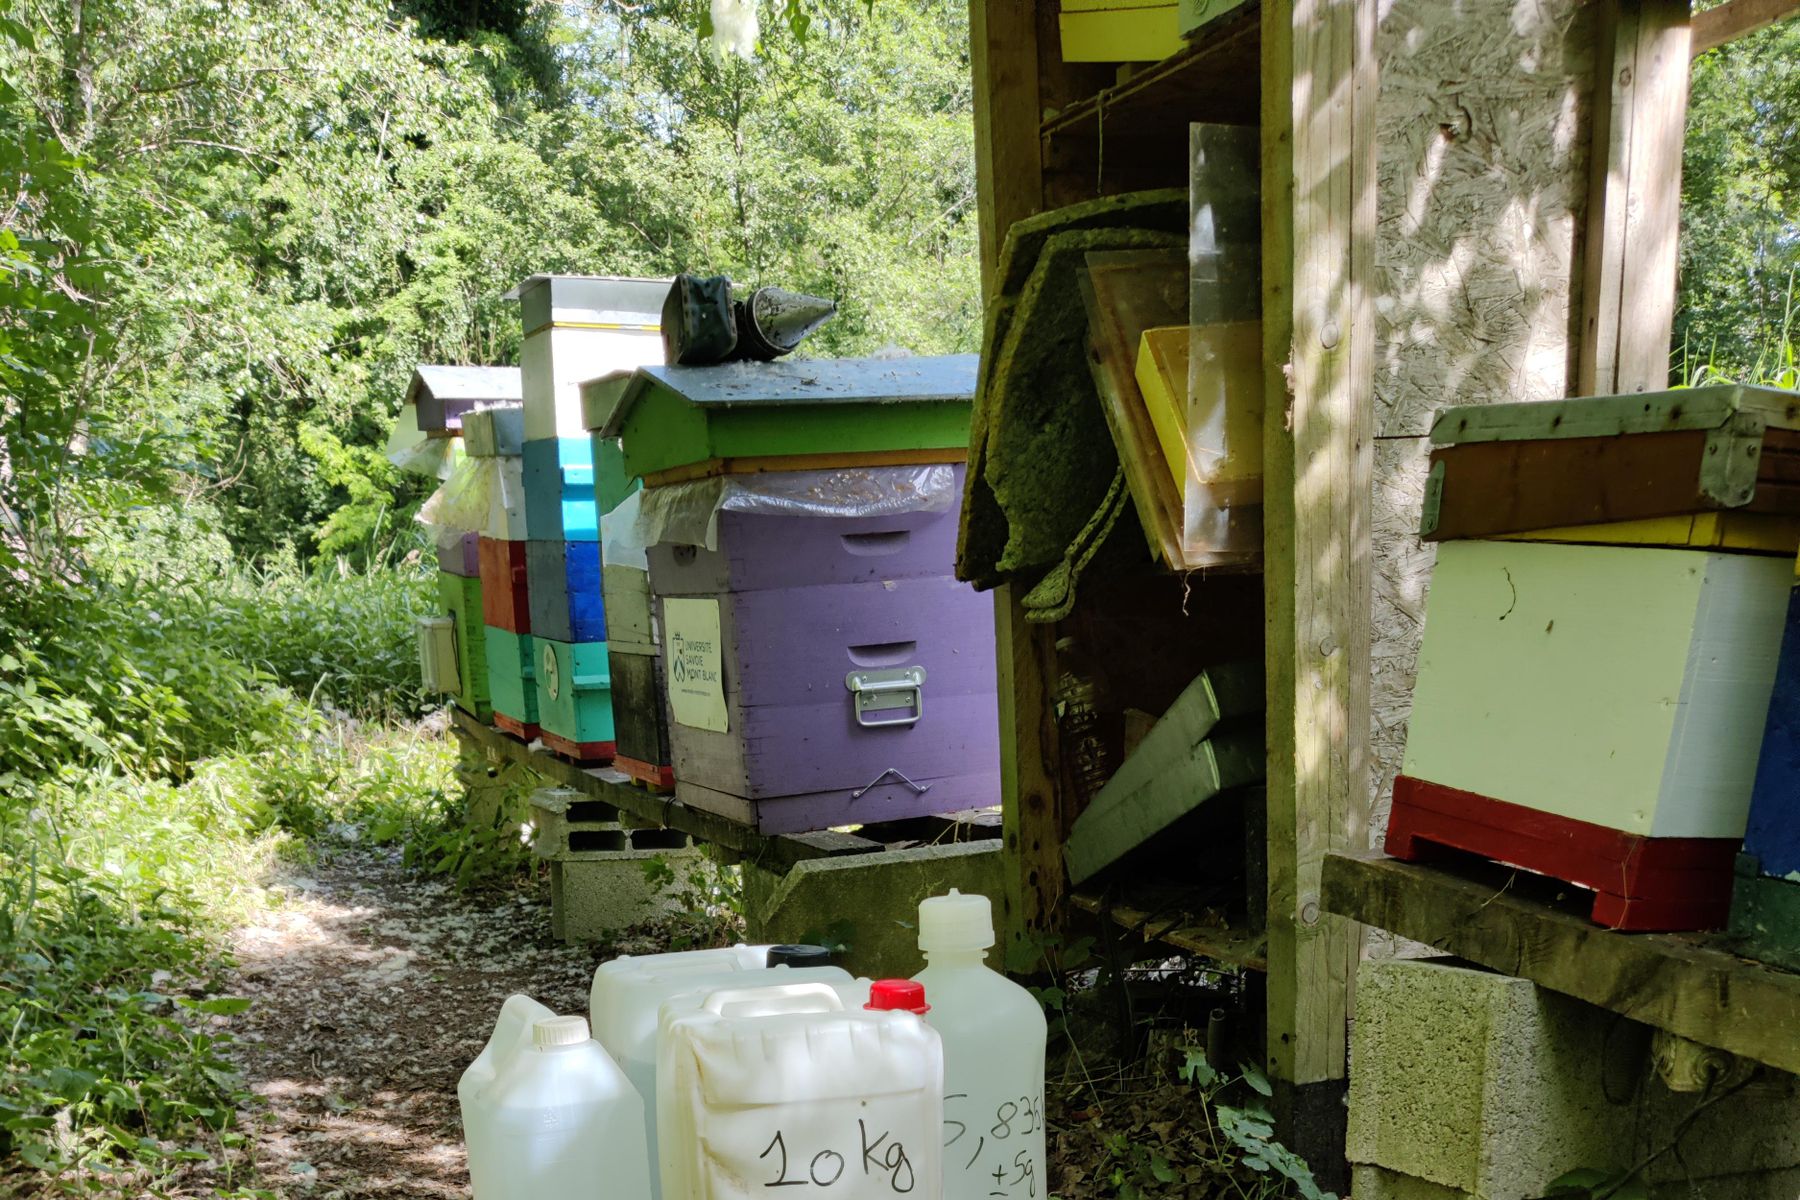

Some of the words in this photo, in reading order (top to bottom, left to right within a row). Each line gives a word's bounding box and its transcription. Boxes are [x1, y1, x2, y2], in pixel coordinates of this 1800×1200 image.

[685, 654, 704, 666] SAVOIE
[686, 668, 701, 680] MONT
[702, 669, 717, 682] BLANC
